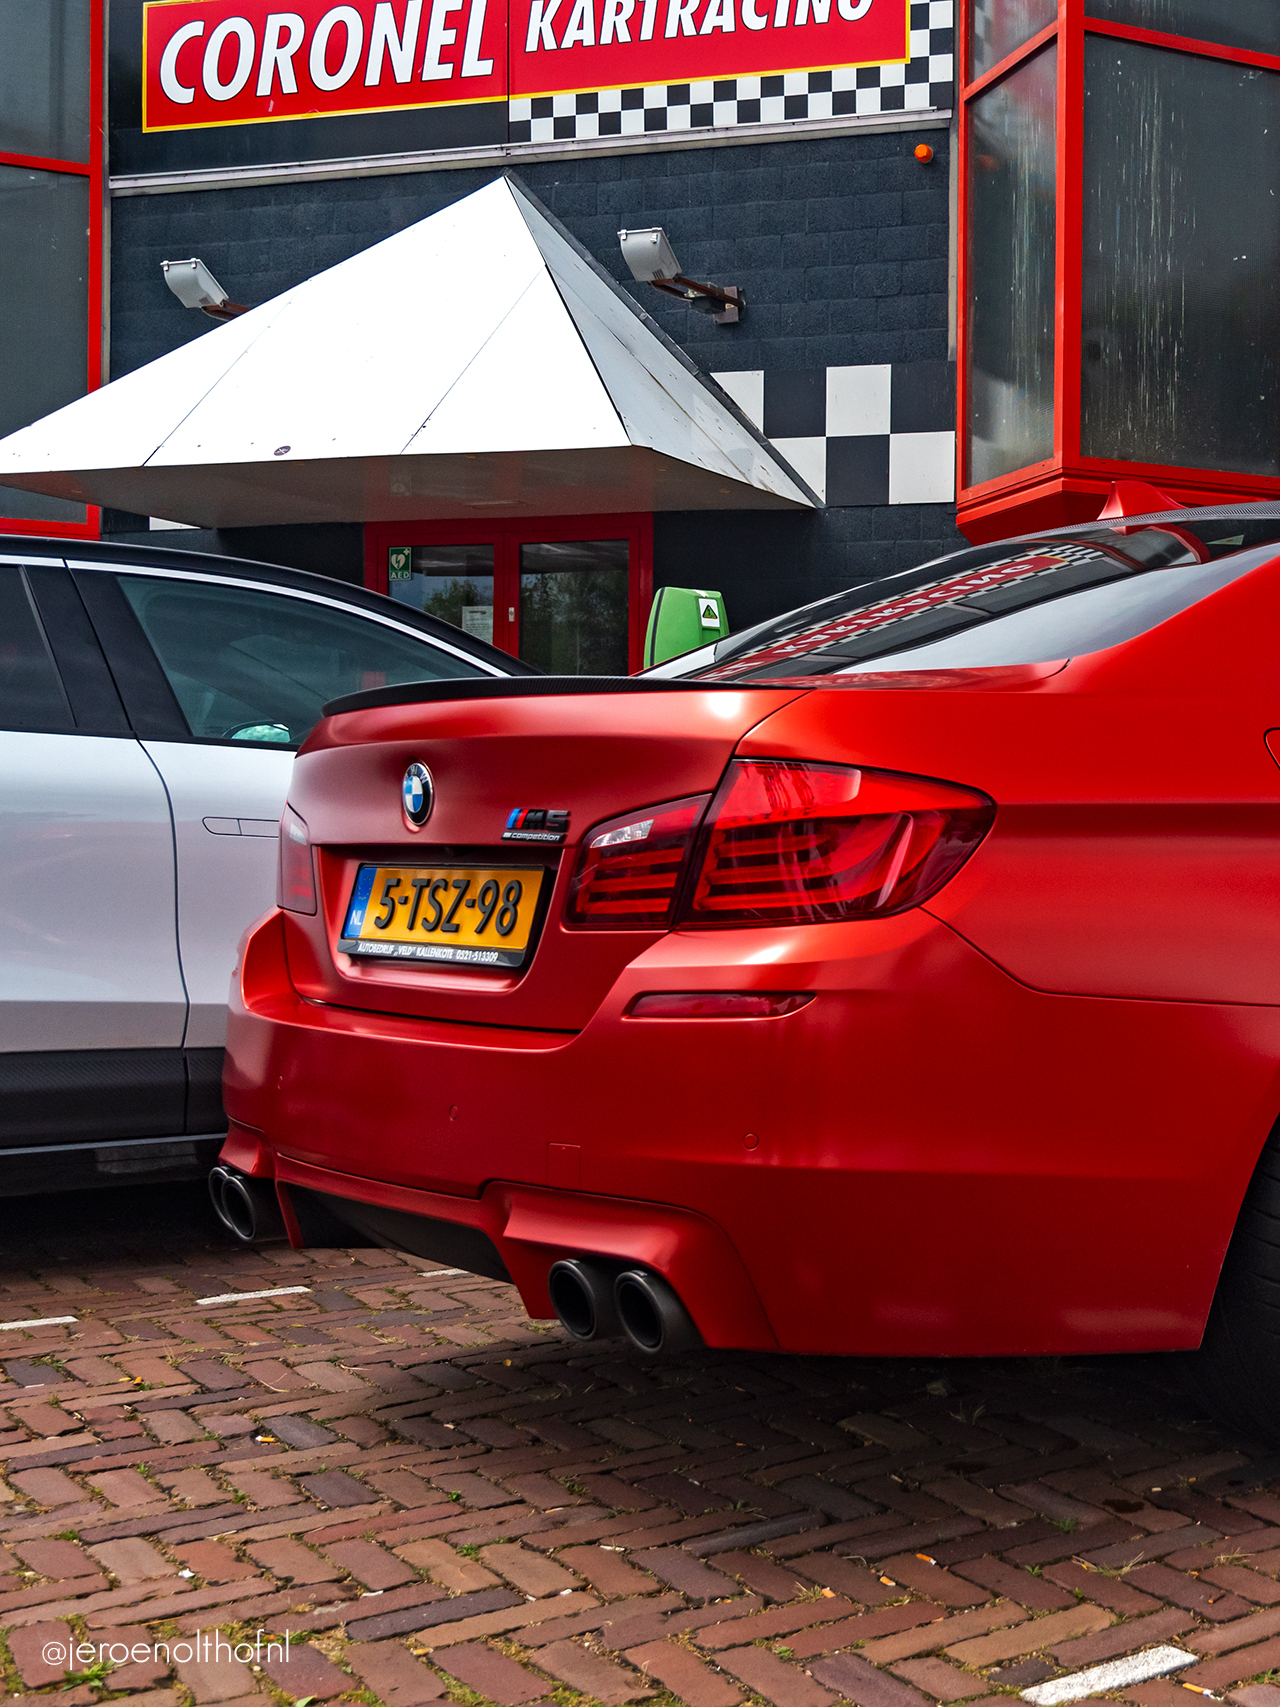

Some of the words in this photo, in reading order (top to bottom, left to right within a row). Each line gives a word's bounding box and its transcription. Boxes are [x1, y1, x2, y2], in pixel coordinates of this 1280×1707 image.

[160, 0, 494, 104] CORONEL
[391, 571, 410, 579] AED
[515, 809, 569, 832] M5
[511, 832, 560, 841] competition
[374, 878, 523, 936] 5-TSZ-98
[350, 910, 362, 925] NL
[358, 943, 394, 954] AUTOBEDRIJF
[456, 949, 499, 963] 0521-513309
